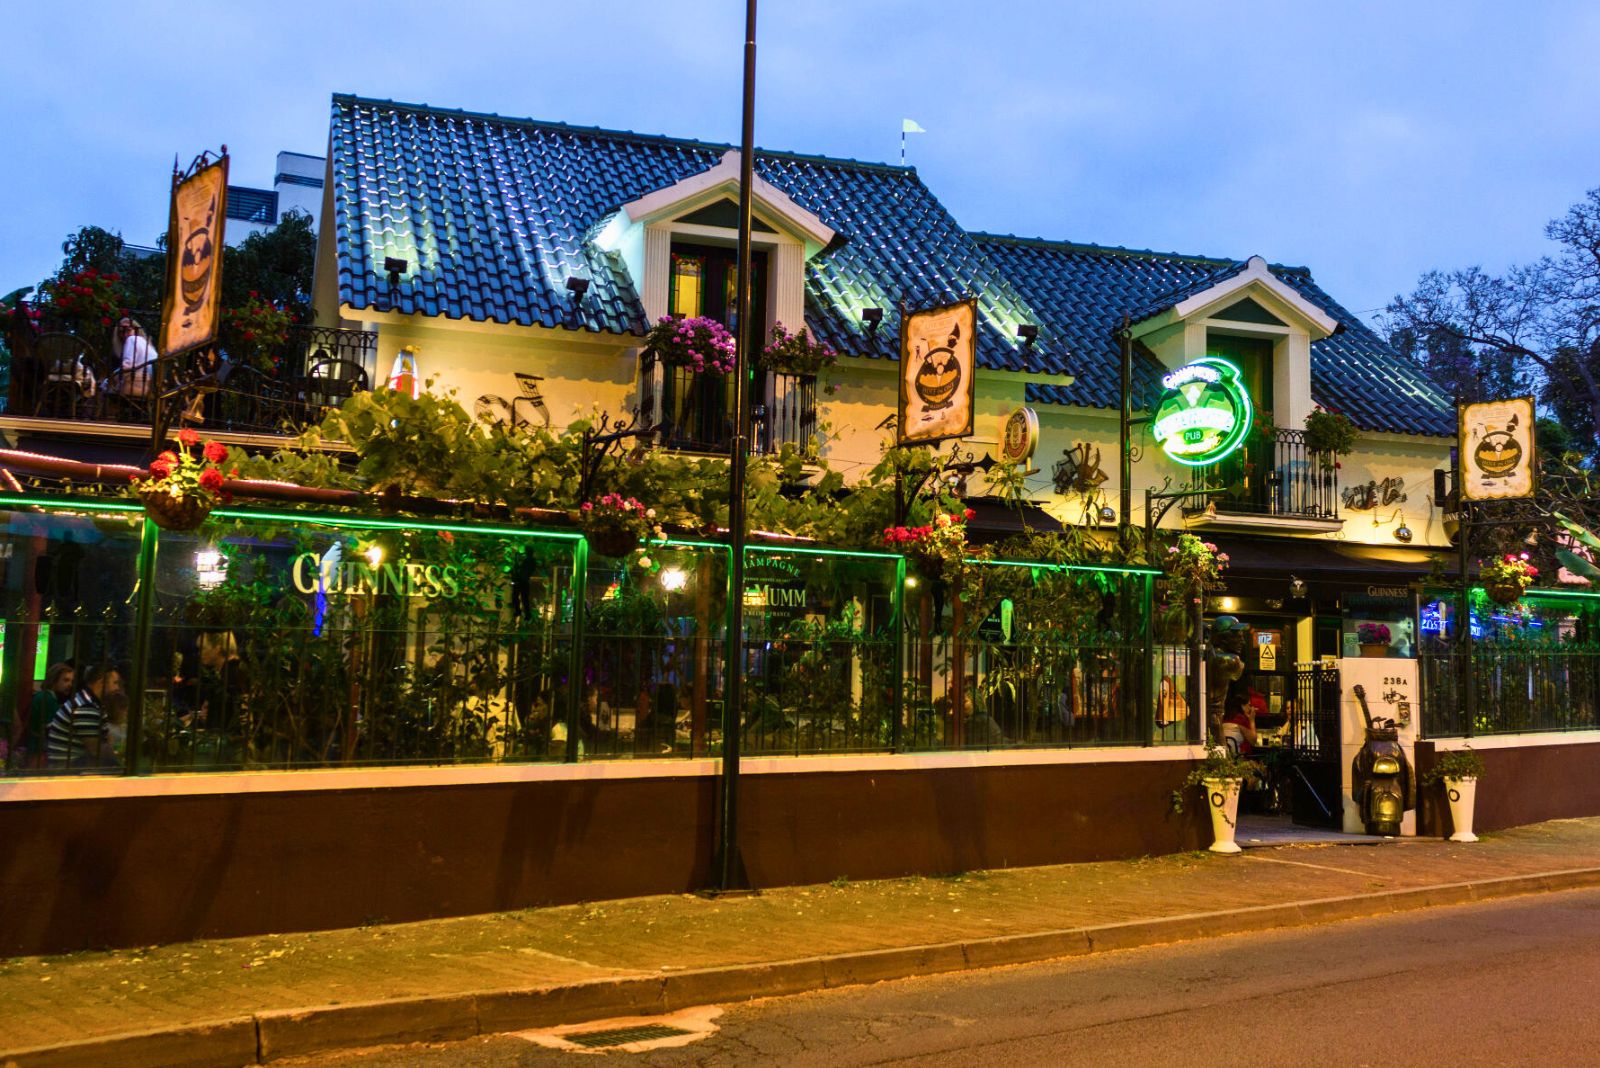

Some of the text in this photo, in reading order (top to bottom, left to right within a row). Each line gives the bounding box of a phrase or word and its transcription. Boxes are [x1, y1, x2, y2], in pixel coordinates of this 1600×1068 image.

[1184, 431, 1202, 441] PUB
[292, 552, 458, 598] GUINNESS
[1367, 585, 1409, 598] GUINNESS
[1383, 677, 1408, 686] 238A
